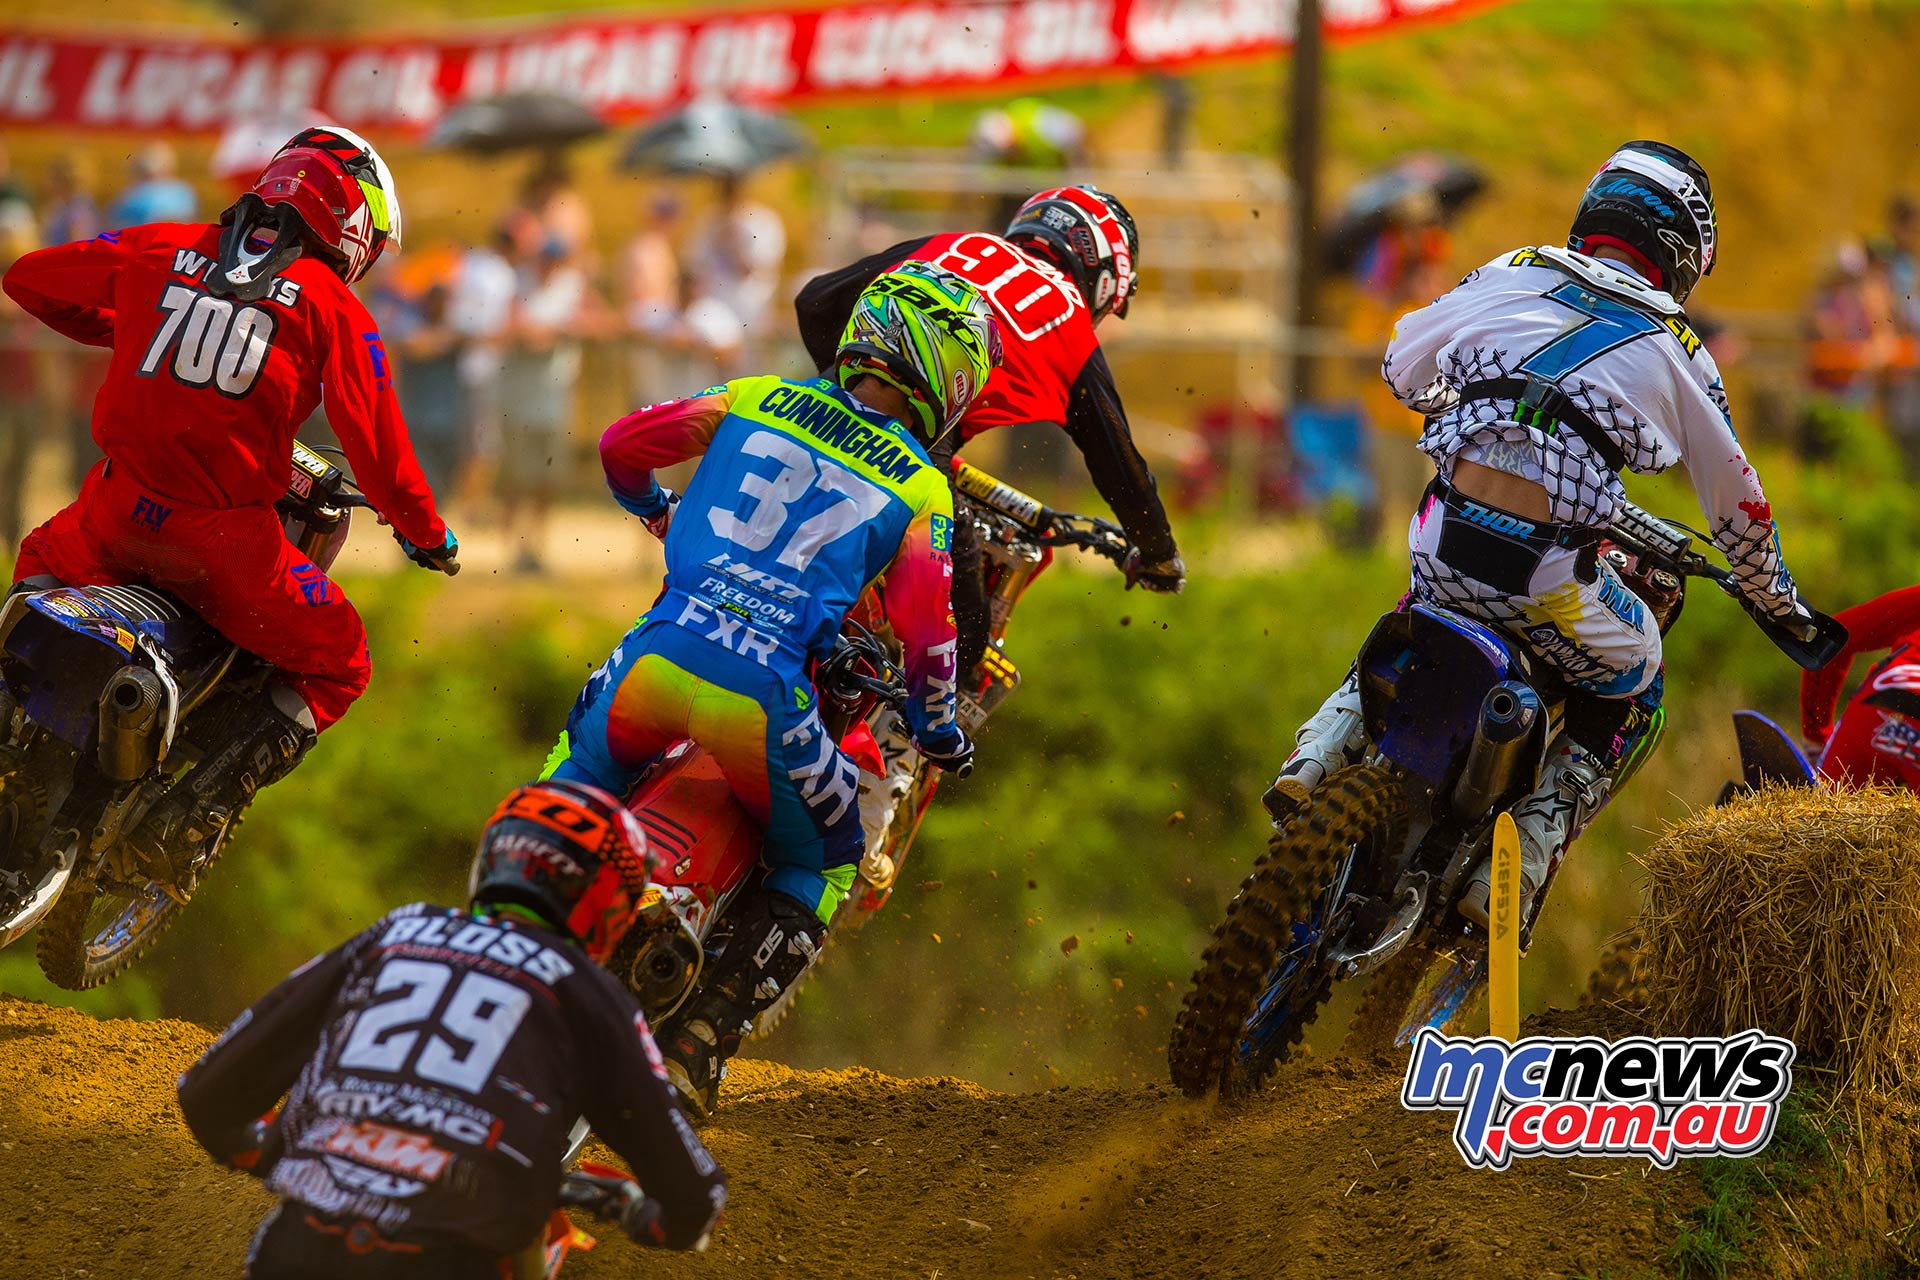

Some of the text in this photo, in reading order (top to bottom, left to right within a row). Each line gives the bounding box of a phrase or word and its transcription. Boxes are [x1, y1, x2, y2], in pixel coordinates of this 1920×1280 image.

[936, 232, 1075, 342] 90
[140, 285, 275, 395] 700
[1508, 280, 1666, 384] 7
[954, 374, 968, 400] BELL
[758, 387, 922, 484] CUNNINGHAM
[134, 495, 172, 527] FLY
[707, 431, 892, 573] 37
[932, 514, 948, 550] FXR
[1459, 500, 1536, 540] THOR
[675, 595, 780, 667] FXR
[699, 576, 796, 625] FREEDOM
[782, 706, 860, 828] FXR
[379, 915, 575, 987] BLOSS
[339, 959, 532, 1094] 29
